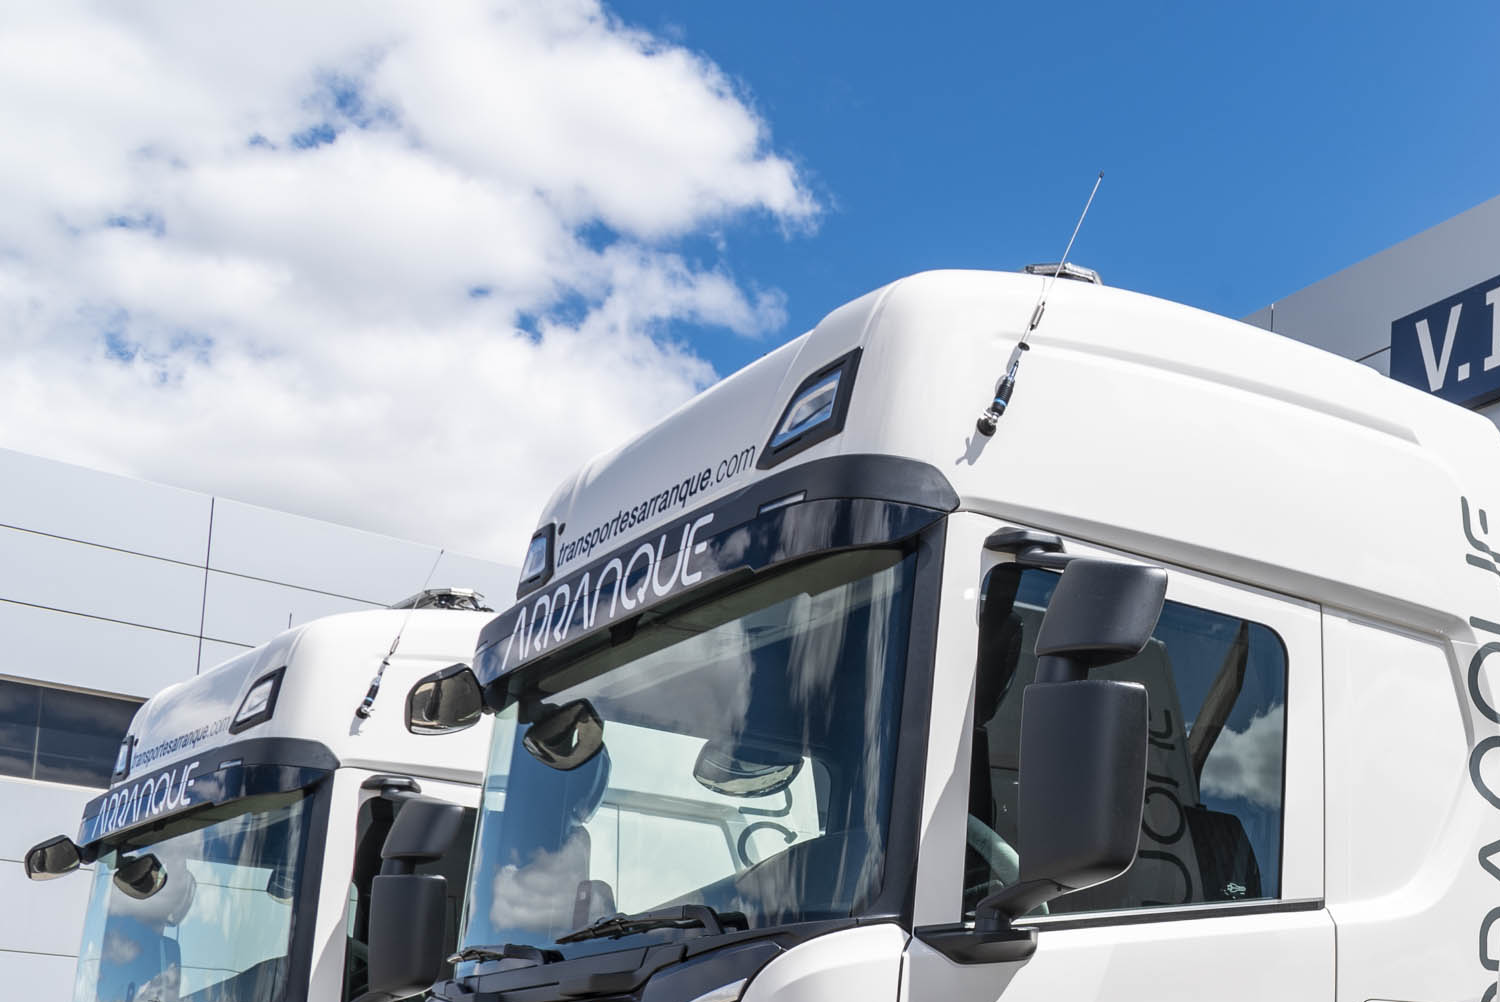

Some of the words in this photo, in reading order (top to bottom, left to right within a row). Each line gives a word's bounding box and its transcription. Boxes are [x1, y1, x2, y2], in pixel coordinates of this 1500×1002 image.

[556, 444, 757, 568] transportesarranque.com
[501, 512, 715, 671] ARRANQUE
[131, 716, 231, 769] transportesarranque.com
[91, 761, 200, 839] ARRANQUE
